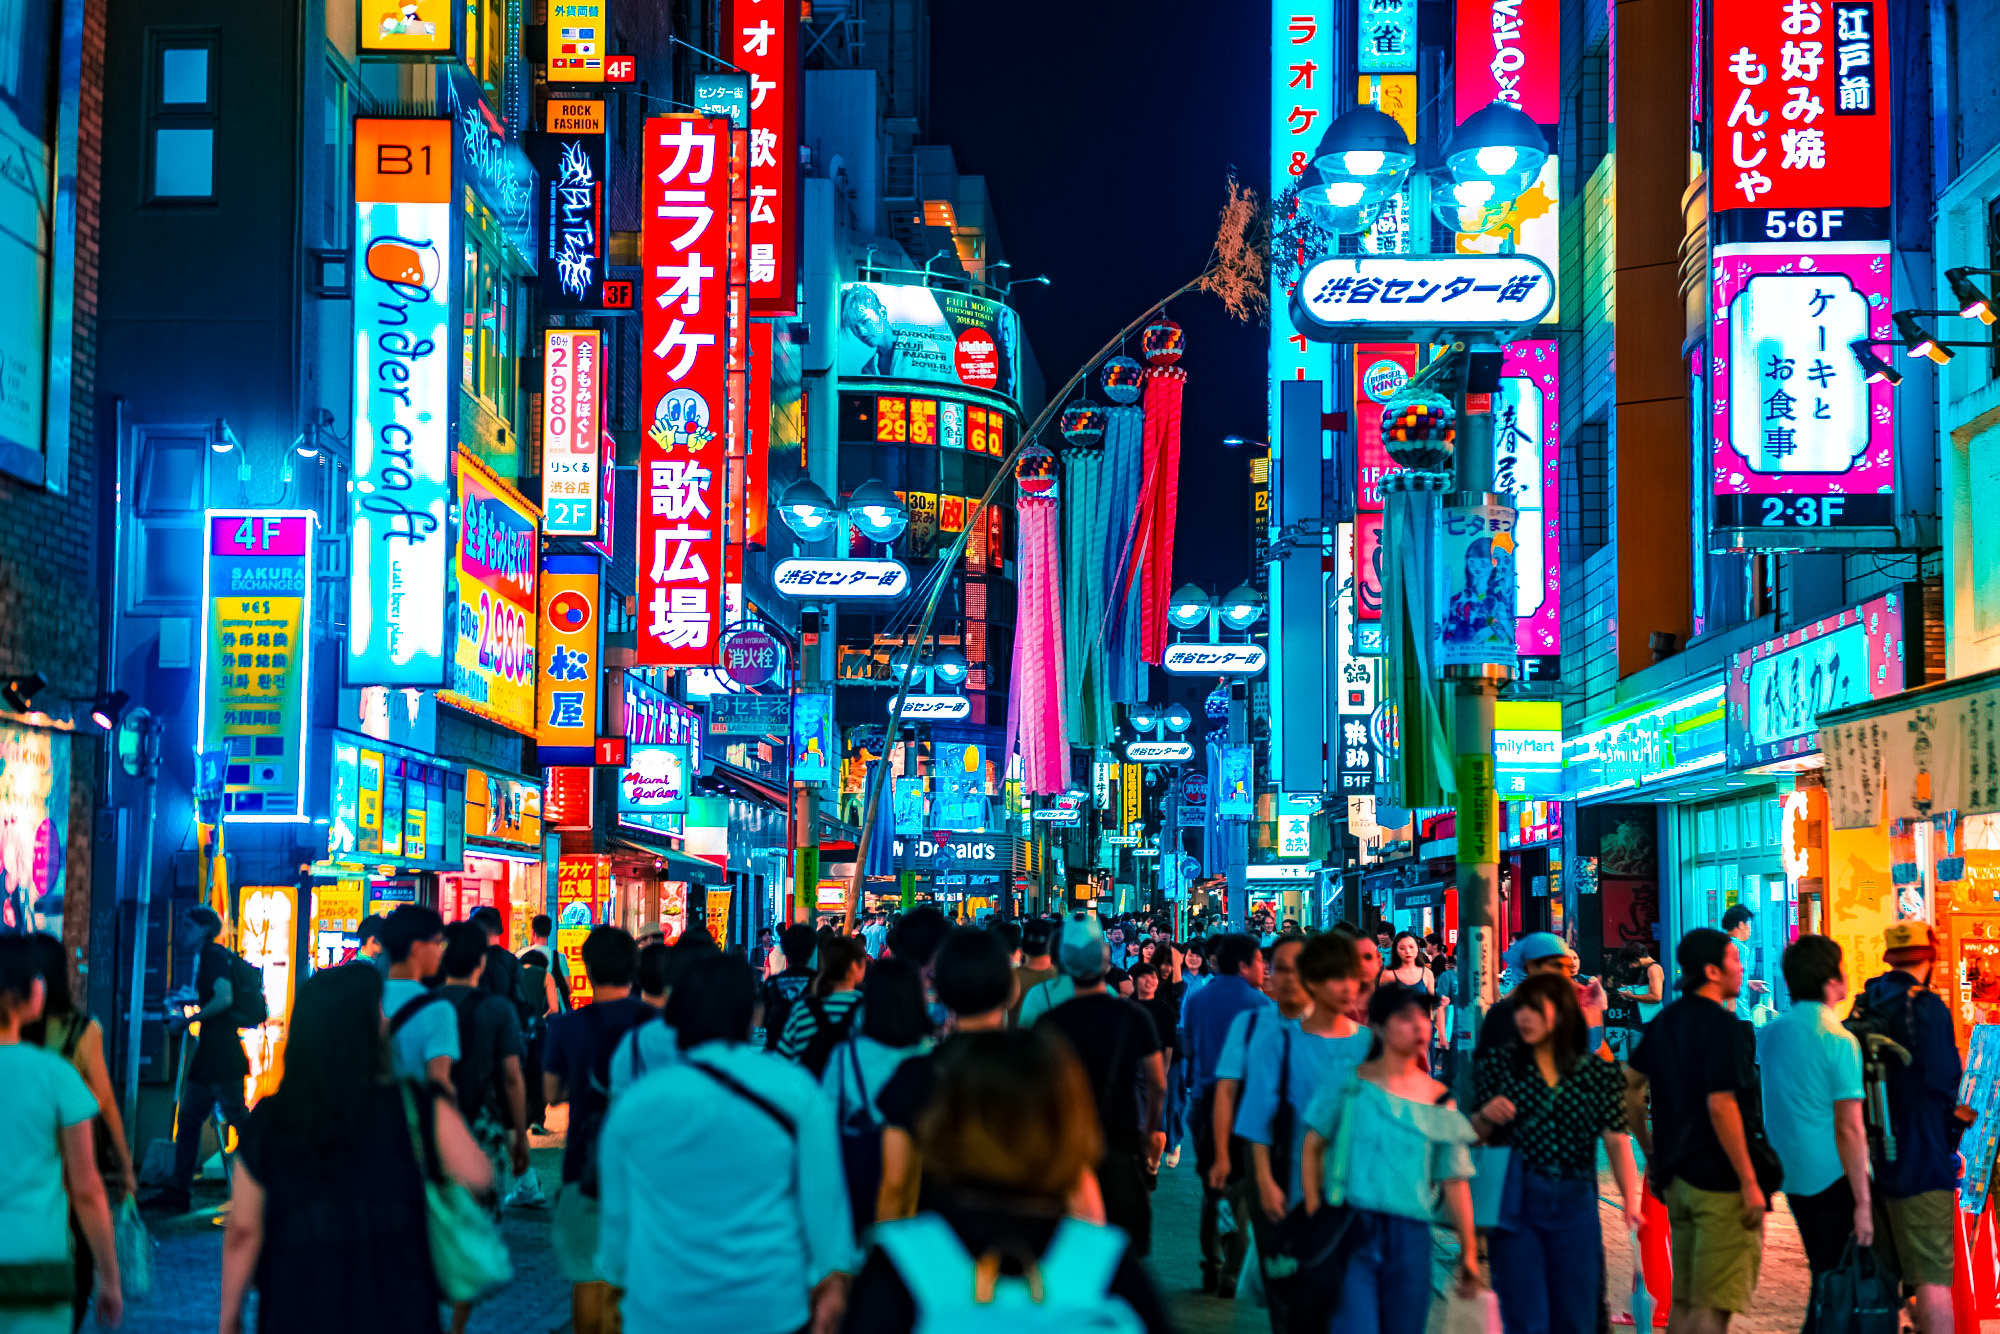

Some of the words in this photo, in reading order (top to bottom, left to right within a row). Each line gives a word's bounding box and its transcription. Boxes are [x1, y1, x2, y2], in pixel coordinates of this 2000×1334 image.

[555, 5, 599, 18] 外貨両替
[1838, 9, 1871, 110] 江戸前
[607, 62, 631, 78] 4F
[698, 86, 744, 99] センター街
[1780, 0, 1826, 169] お好み焼
[562, 105, 592, 116] ROCK
[554, 119, 599, 130] FASHION
[1727, 46, 1772, 202] もんじゃ
[743, 0, 777, 282] オケ歌広場
[377, 145, 431, 175] B1
[653, 121, 716, 382] カラオケ
[607, 286, 629, 304] 3F
[1313, 275, 1543, 304] 渋谷センター街
[550, 336, 569, 348] 60分
[1807, 289, 1836, 420] ケーキと
[1370, 370, 1400, 384] BURGER
[1371, 378, 1403, 393] KING
[575, 341, 593, 450] 全身もみほぐし
[1764, 354, 1797, 459] お食事
[551, 462, 590, 474] りらくる
[361, 423, 439, 547] craft
[550, 481, 590, 495] 渋谷店
[910, 494, 935, 509] 30分
[554, 503, 587, 524] 2F
[234, 517, 281, 550] 4F
[649, 460, 714, 649] 歌広場
[231, 567, 304, 580] SAKURA
[779, 570, 902, 588] 渋谷センター街
[728, 646, 774, 669] 消火栓
[1169, 652, 1262, 665] 渋谷センター街
[547, 646, 589, 728] 松屋
[603, 743, 621, 763] 1F
[1130, 746, 1189, 757] 渋谷センター街
[1497, 740, 1555, 754] milyMart
[622, 772, 670, 785] Miami
[1343, 775, 1371, 787] B1F
[1511, 776, 1526, 792] 酒
[559, 862, 593, 878] ラオケ
[559, 879, 592, 897] 広場
